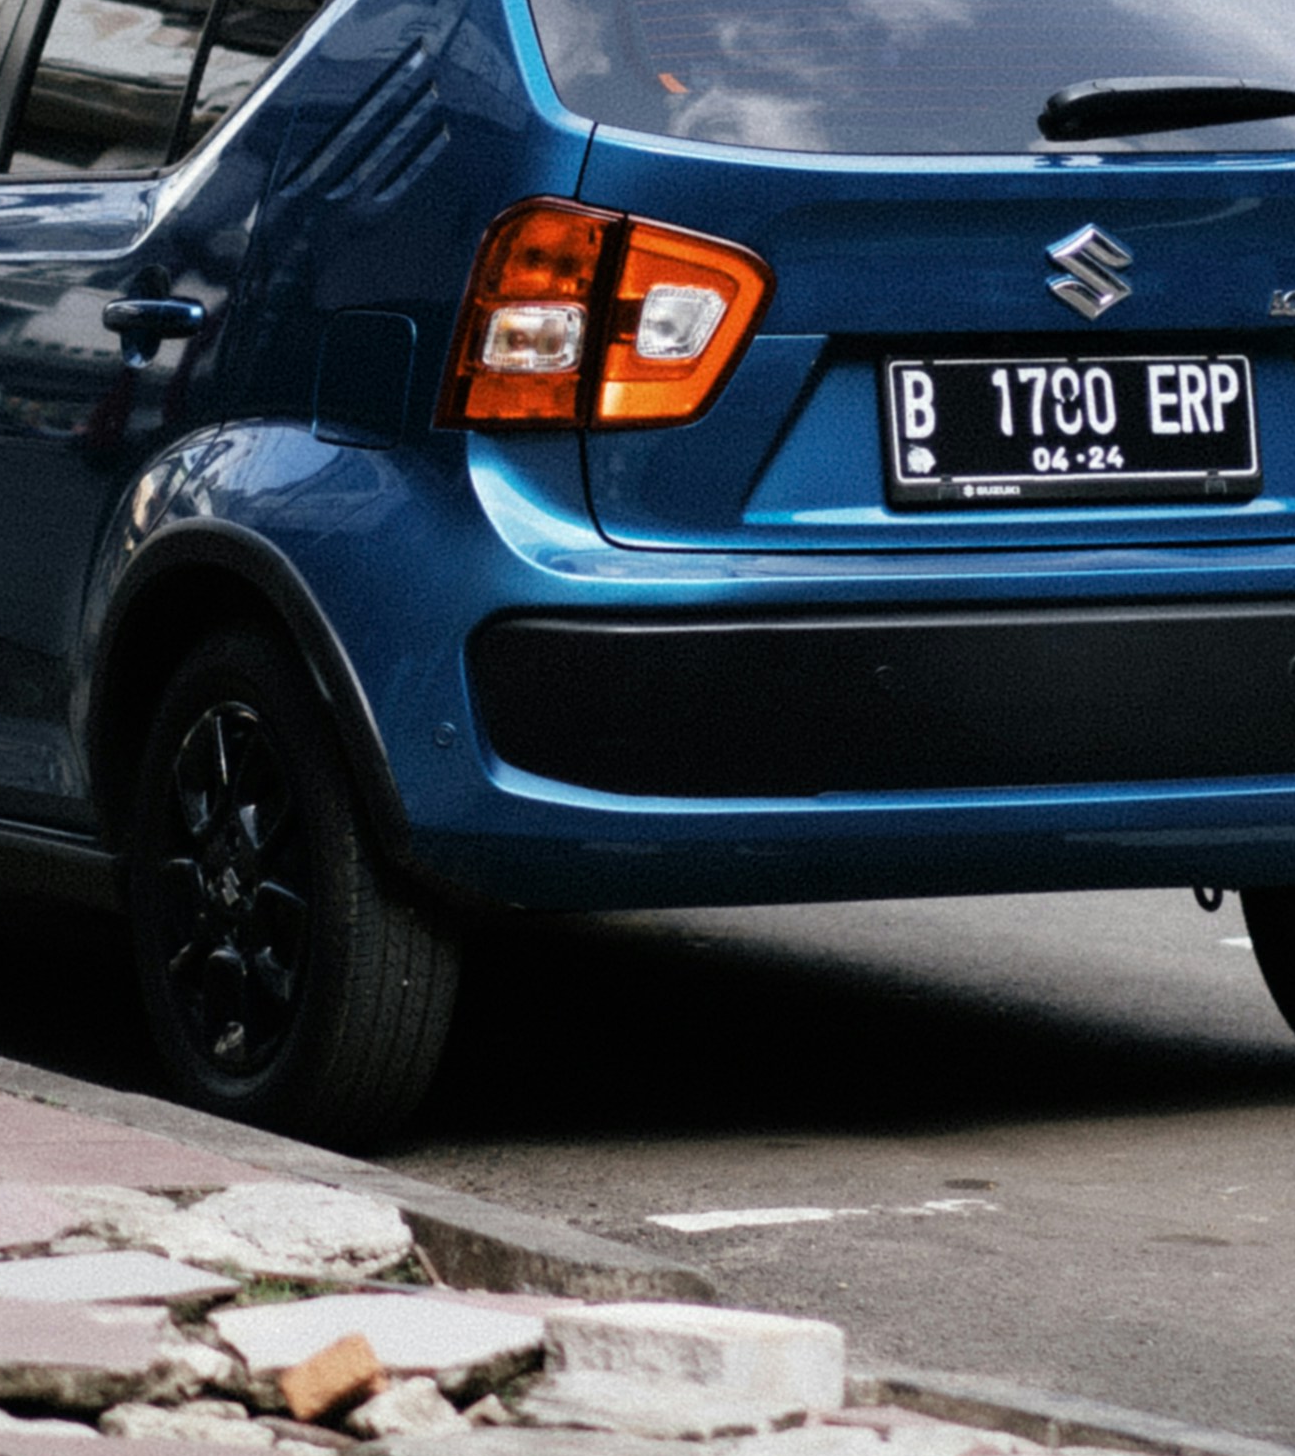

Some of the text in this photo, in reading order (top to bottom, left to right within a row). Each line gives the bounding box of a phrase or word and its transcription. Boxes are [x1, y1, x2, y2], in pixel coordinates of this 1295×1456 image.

[901, 369, 936, 439] B
[1147, 364, 1240, 435] ERP
[976, 485, 1022, 496] SUZUKI
